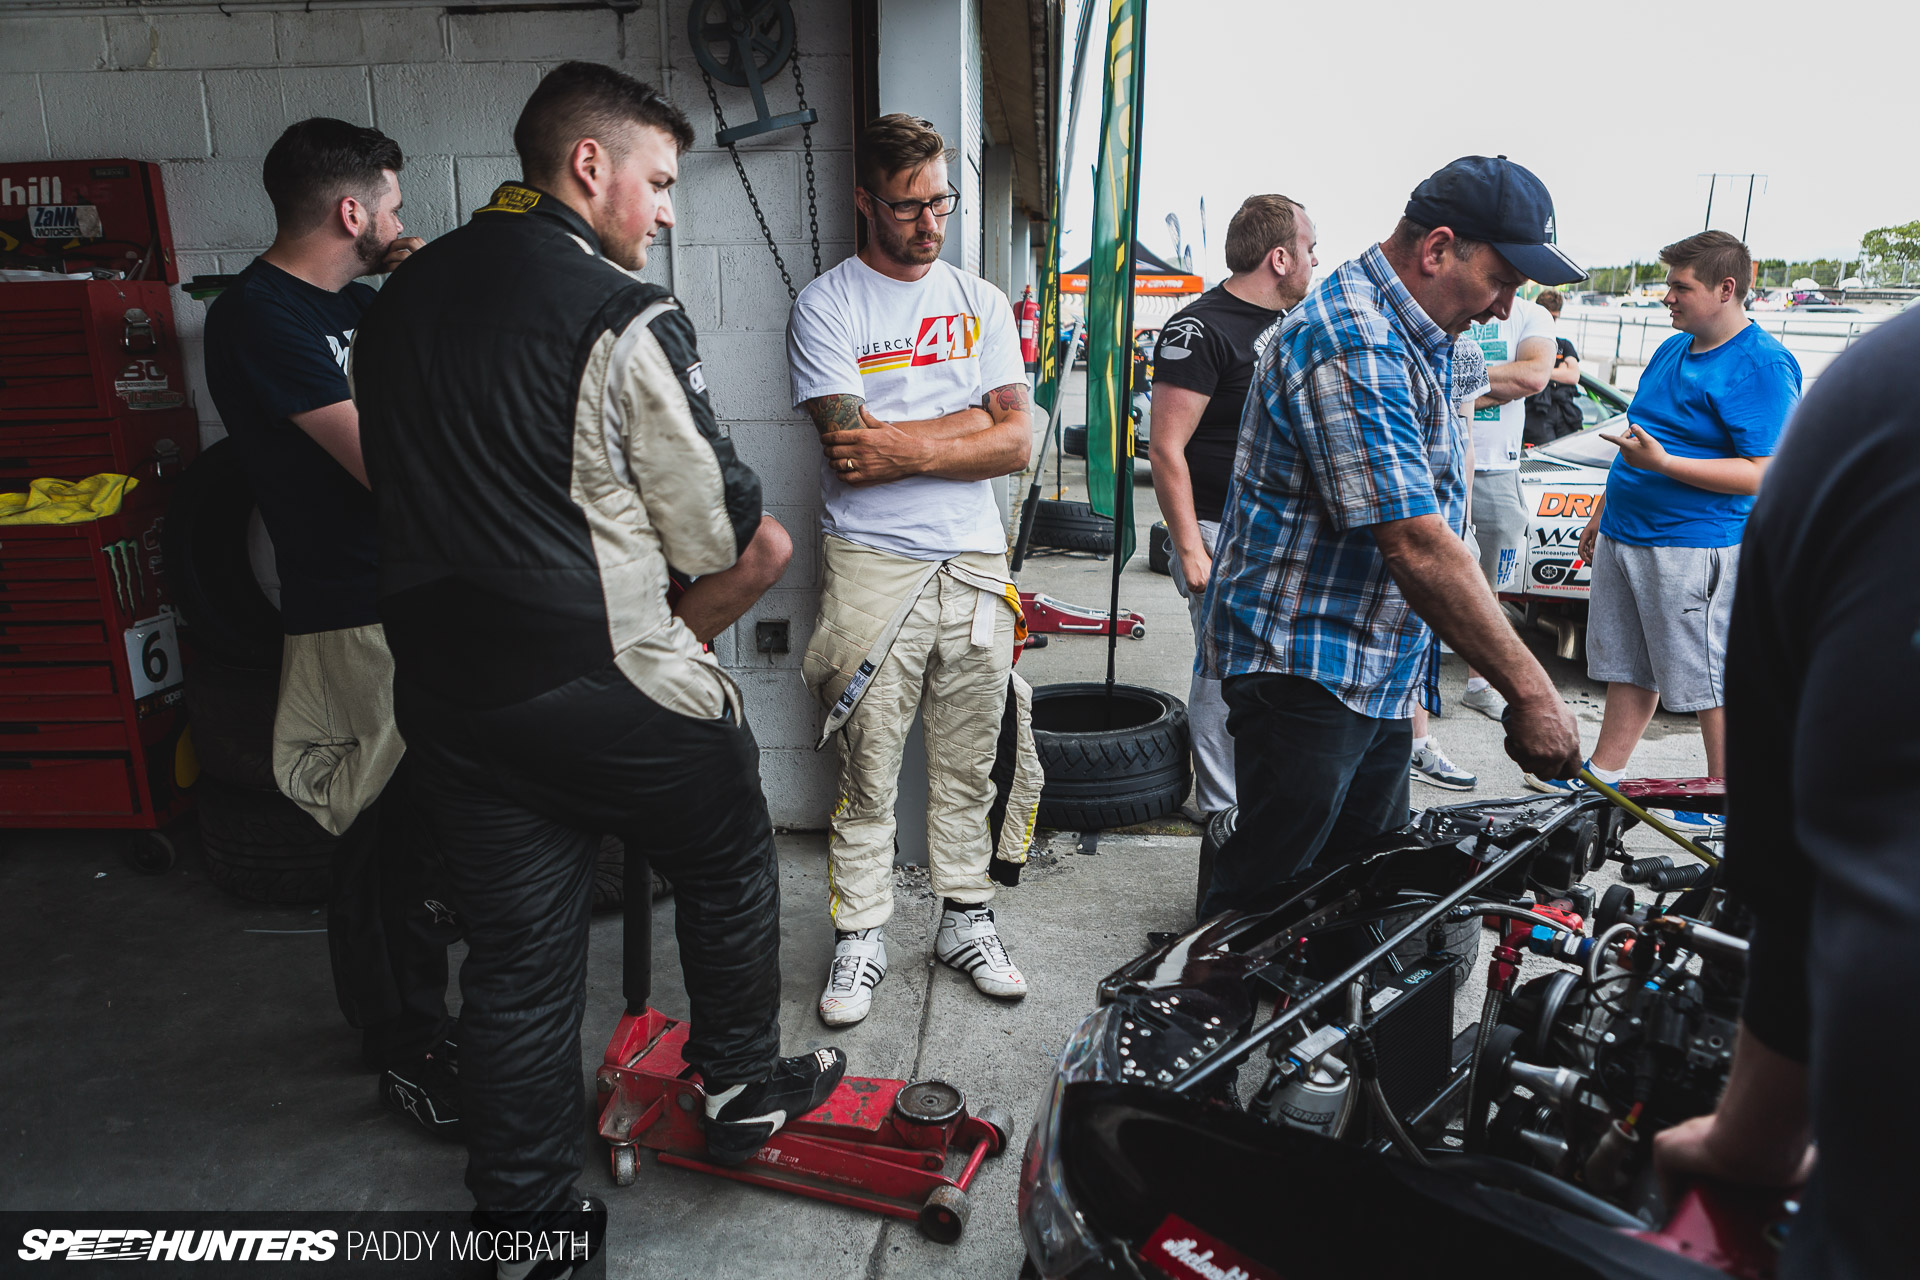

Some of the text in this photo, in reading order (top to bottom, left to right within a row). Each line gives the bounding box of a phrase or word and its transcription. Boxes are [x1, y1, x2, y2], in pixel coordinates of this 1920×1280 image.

[34, 206, 80, 227] ZaNN
[35, 227, 82, 237] MOTORSPO
[857, 337, 913, 355] UERCK
[1532, 549, 1579, 557] westcoastperfo
[142, 630, 169, 683] 6
